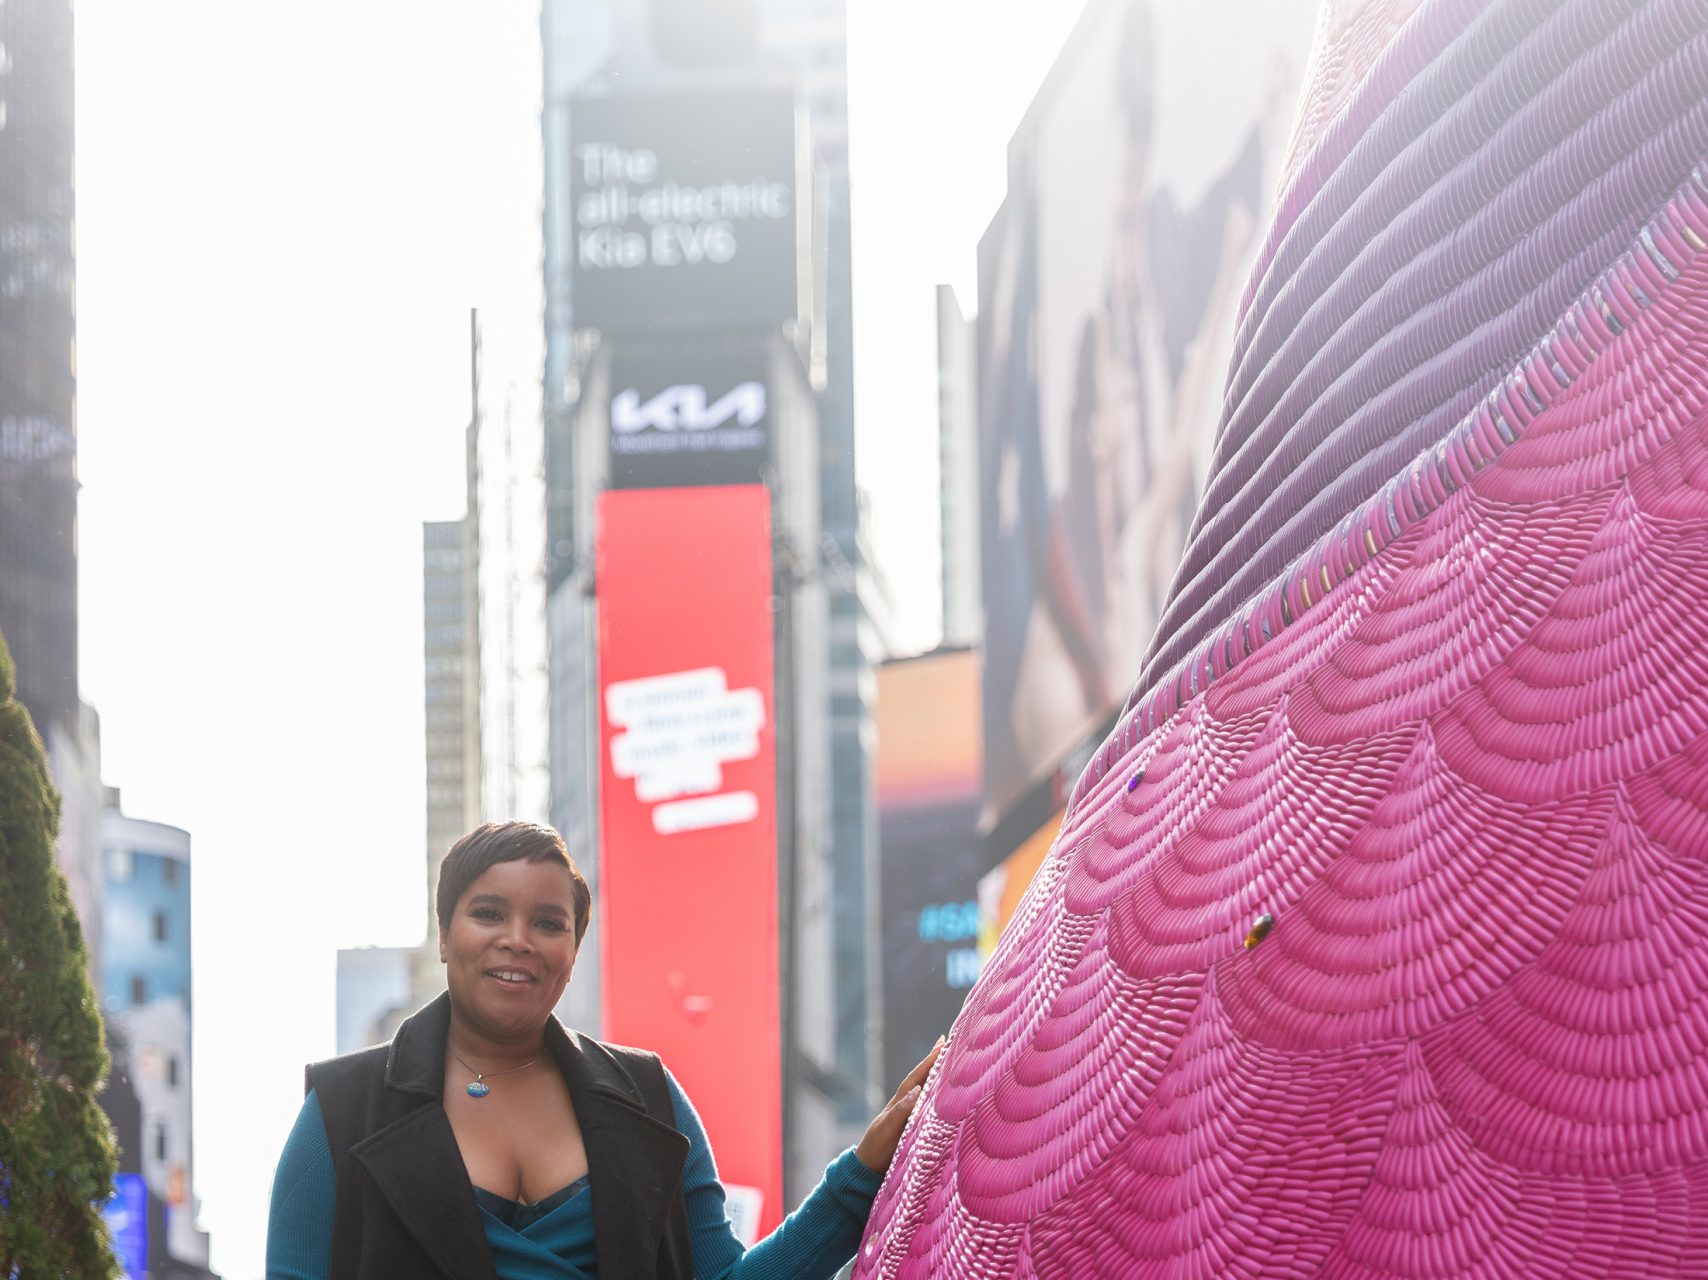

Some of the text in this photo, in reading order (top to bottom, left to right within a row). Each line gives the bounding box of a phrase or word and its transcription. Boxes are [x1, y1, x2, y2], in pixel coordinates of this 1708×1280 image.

[576, 142, 658, 185] The
[577, 177, 791, 229] all-electric
[579, 221, 737, 270] Kia EV6
